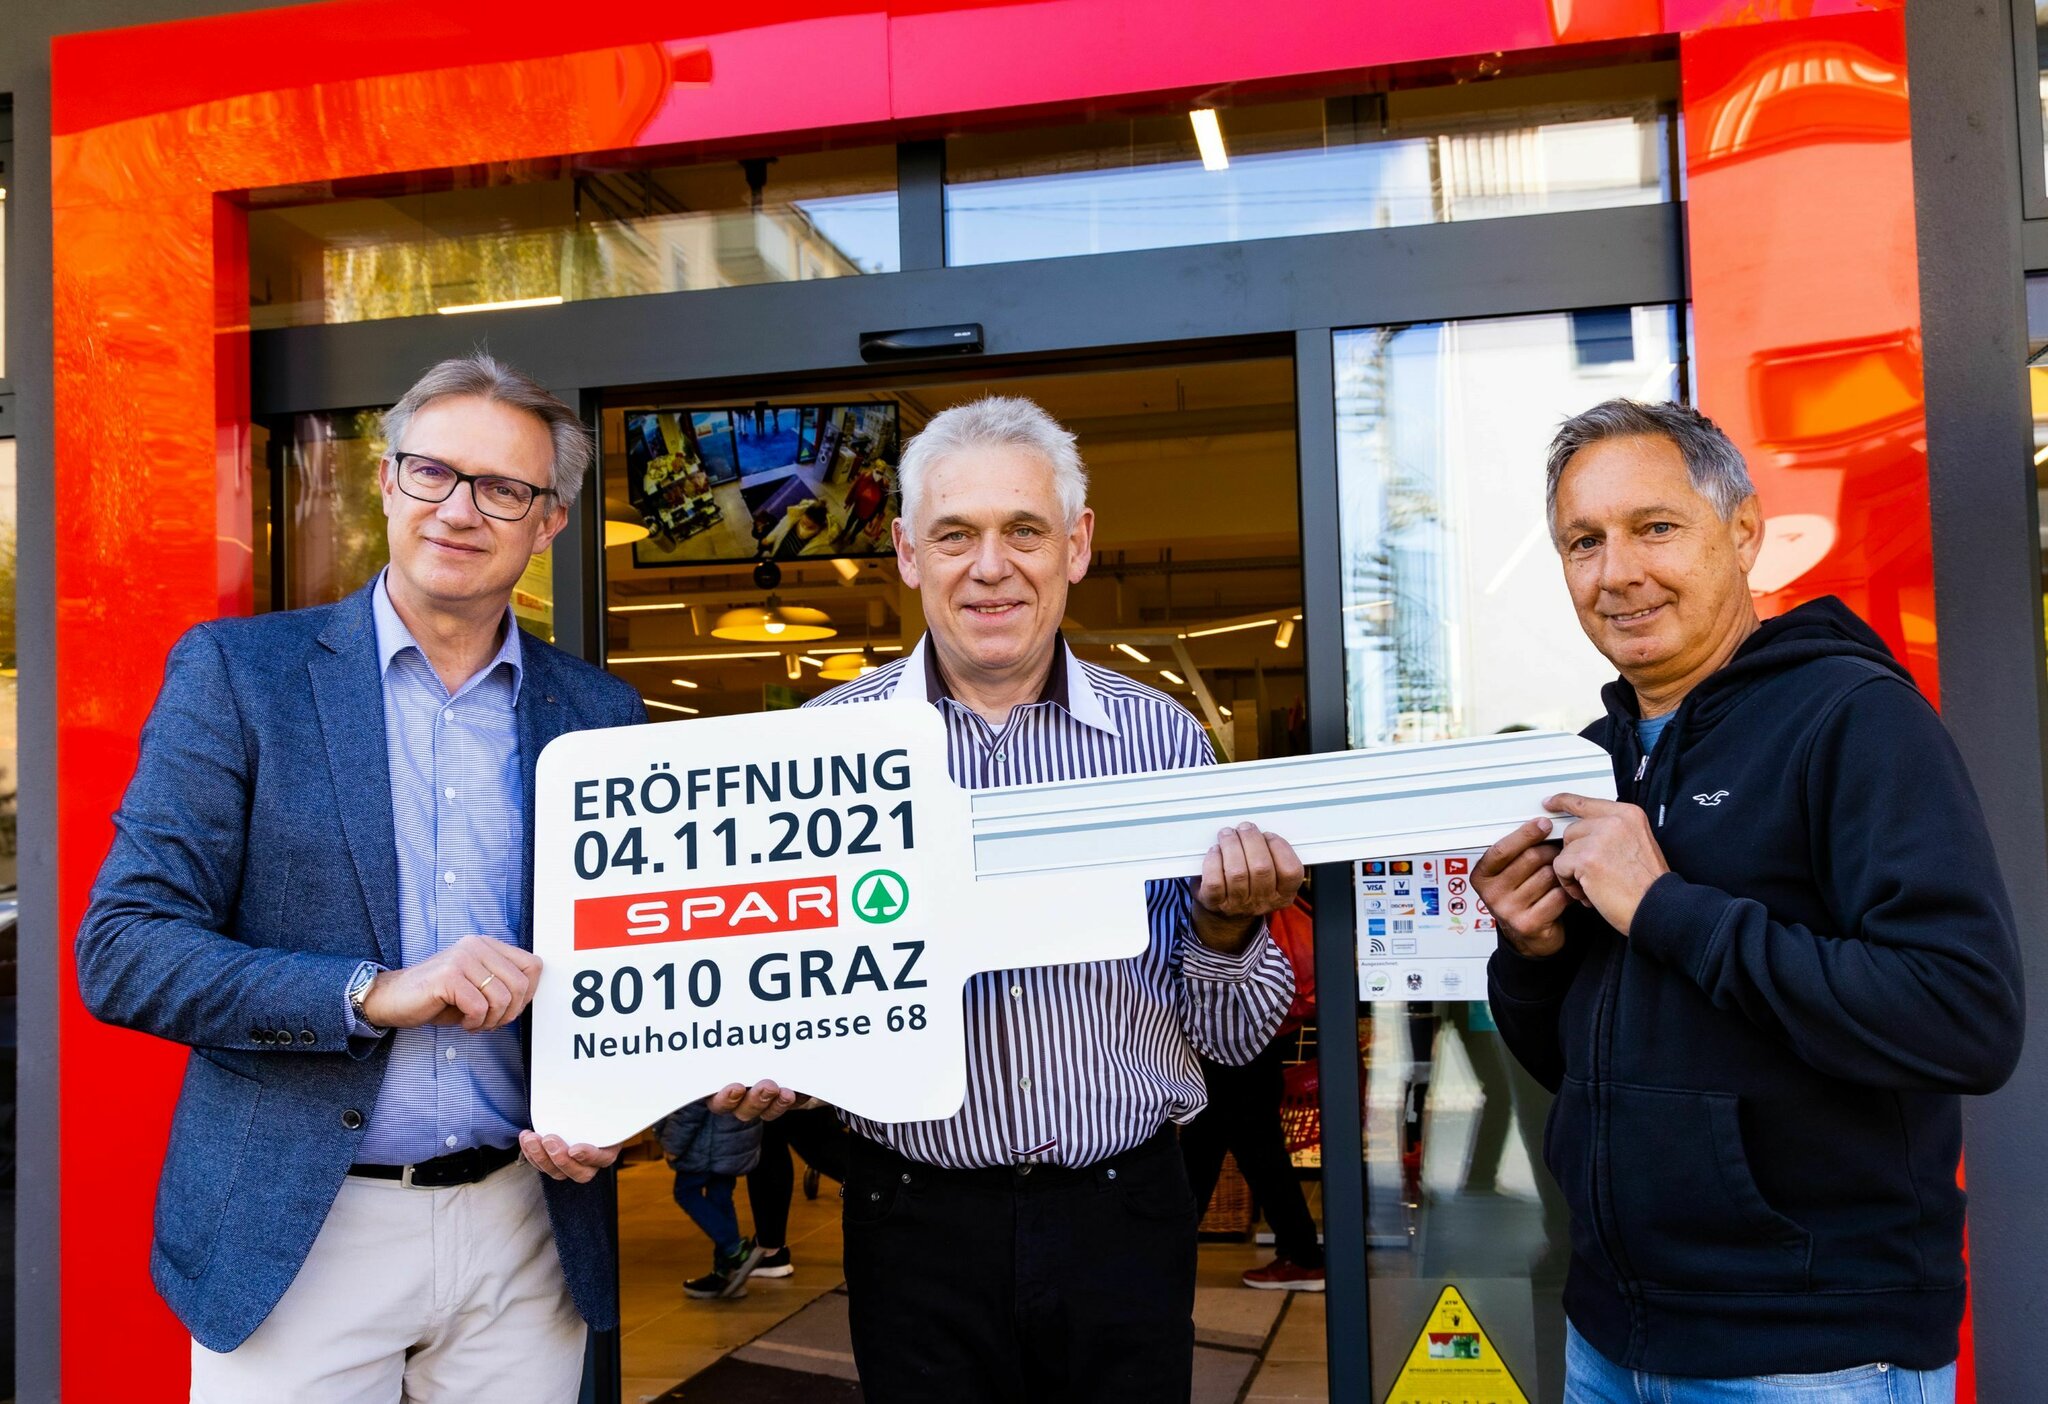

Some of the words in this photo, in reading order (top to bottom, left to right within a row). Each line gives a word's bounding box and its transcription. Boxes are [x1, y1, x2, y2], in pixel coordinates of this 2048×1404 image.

[574, 748, 911, 822] ERÖFFNUNG
[574, 800, 914, 881] 04.11.2021
[626, 885, 833, 936] SPAR
[1366, 884, 1384, 892] VISA
[571, 959, 722, 1019] 8010
[748, 940, 928, 1002] GRAZ
[573, 1015, 871, 1060] Neuholdaugasse
[886, 1003, 927, 1033] 68
